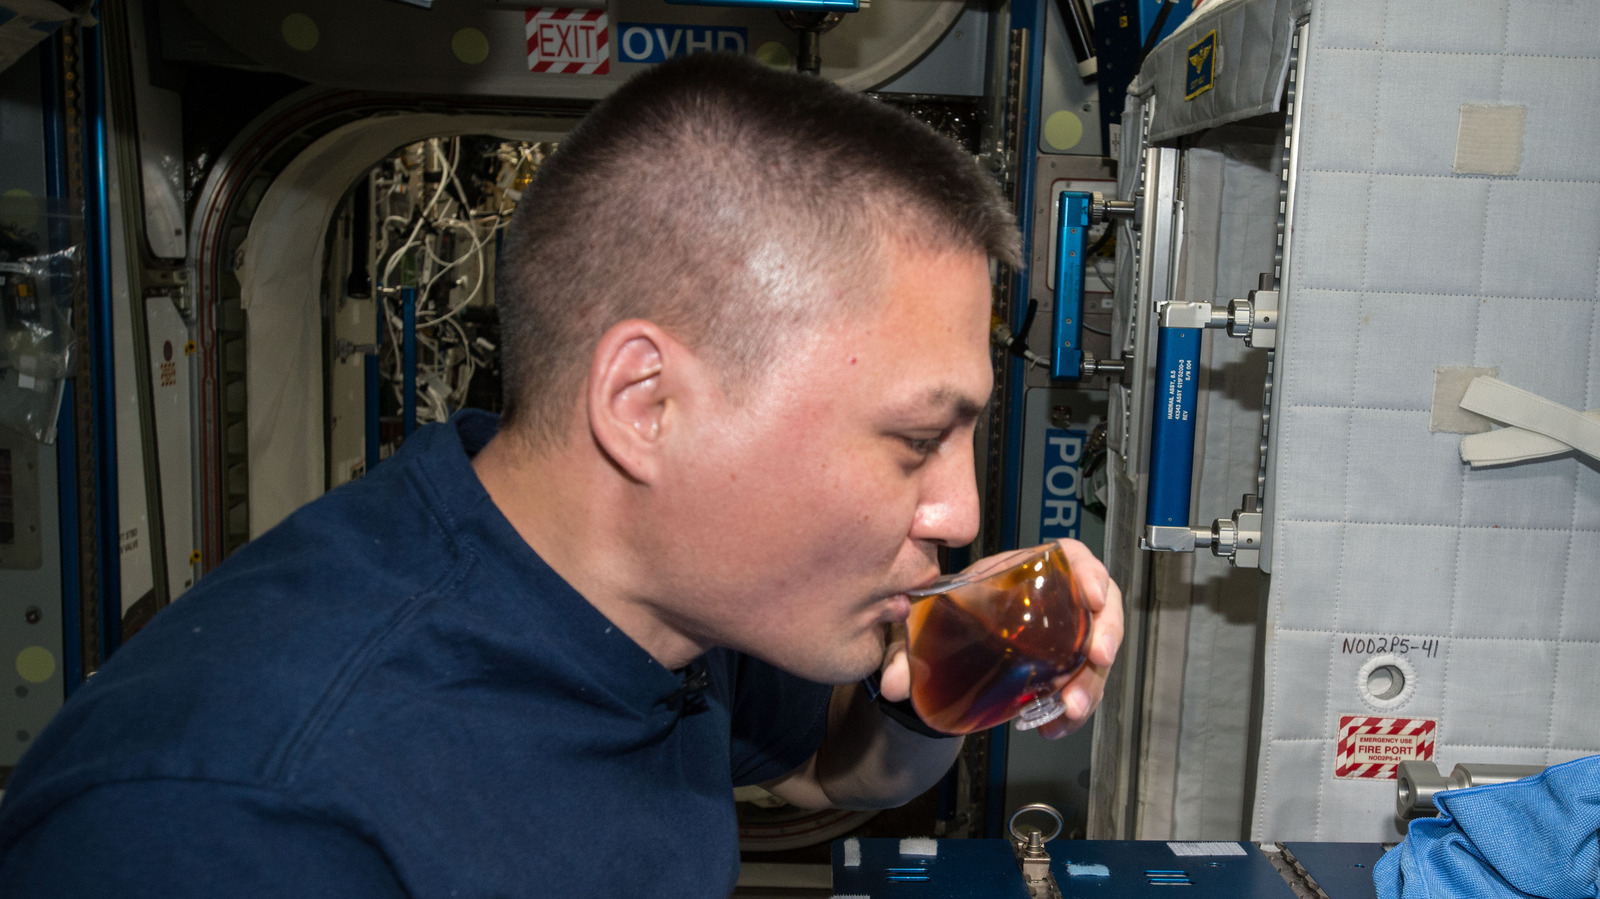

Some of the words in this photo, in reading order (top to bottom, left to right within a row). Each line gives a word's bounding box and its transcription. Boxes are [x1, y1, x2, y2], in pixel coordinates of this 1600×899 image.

[539, 24, 595, 59] EXIT
[622, 26, 745, 60] OVHD
[1342, 636, 1439, 658] NOD2P5-41
[1358, 745, 1381, 754] FIRE
[1384, 746, 1413, 755] PORT
